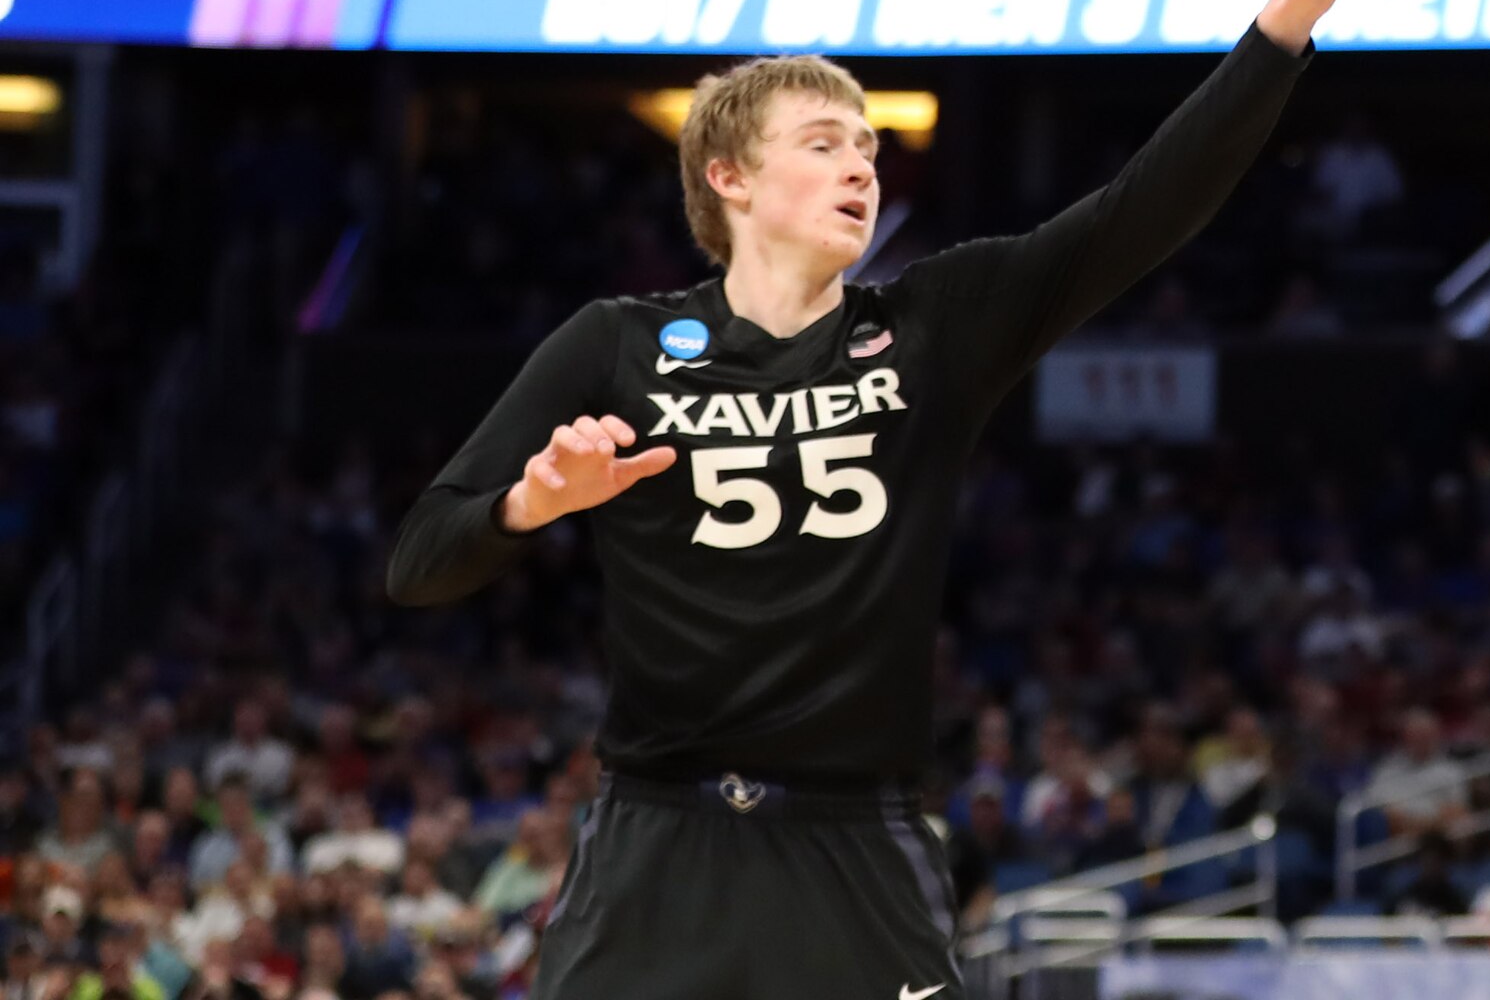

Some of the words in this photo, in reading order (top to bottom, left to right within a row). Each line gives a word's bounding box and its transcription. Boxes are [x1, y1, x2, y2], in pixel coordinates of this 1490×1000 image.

[664, 333, 706, 352] NCAA
[646, 367, 909, 438] XAVIER
[690, 432, 888, 549] 55
